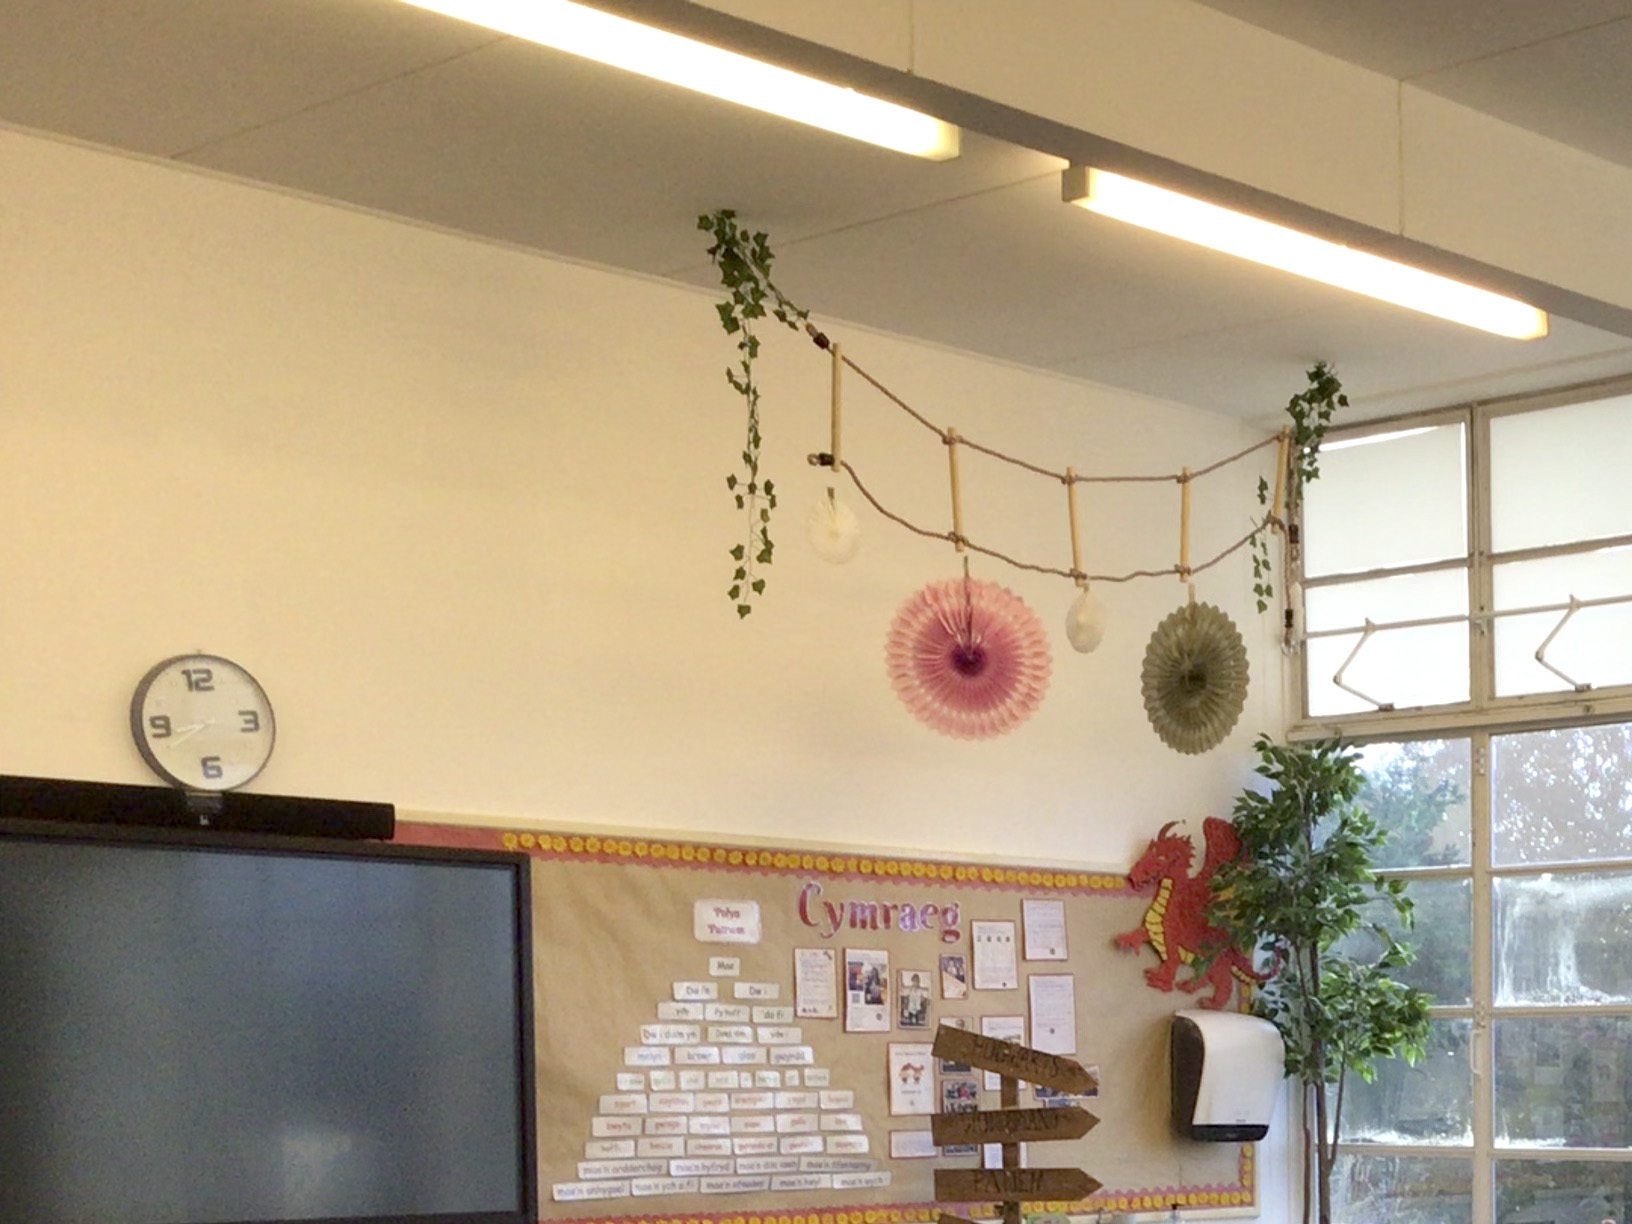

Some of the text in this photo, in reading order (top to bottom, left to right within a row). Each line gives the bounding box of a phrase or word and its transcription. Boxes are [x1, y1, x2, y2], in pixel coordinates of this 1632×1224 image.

[180, 667, 215, 692] 12
[149, 715, 172, 738] 9
[238, 710, 260, 733] 3
[201, 756, 223, 779] 6
[798, 881, 962, 944] Cymraeg
